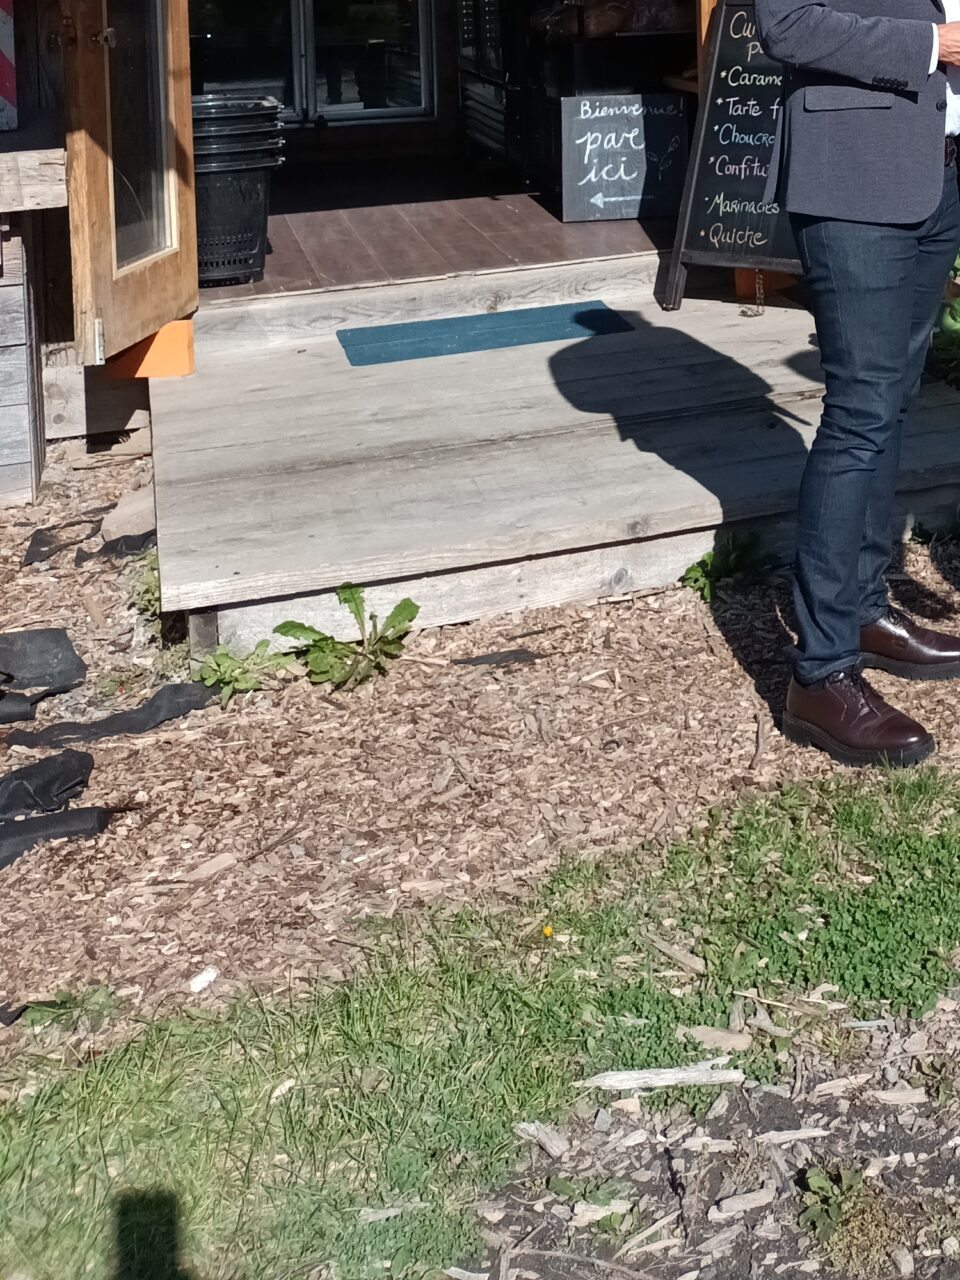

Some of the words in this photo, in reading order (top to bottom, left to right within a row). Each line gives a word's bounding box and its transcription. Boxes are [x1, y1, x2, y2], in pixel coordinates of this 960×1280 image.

[726, 97, 762, 116] Tarte
[578, 156, 638, 185] ici
[709, 222, 768, 248] Quiche
